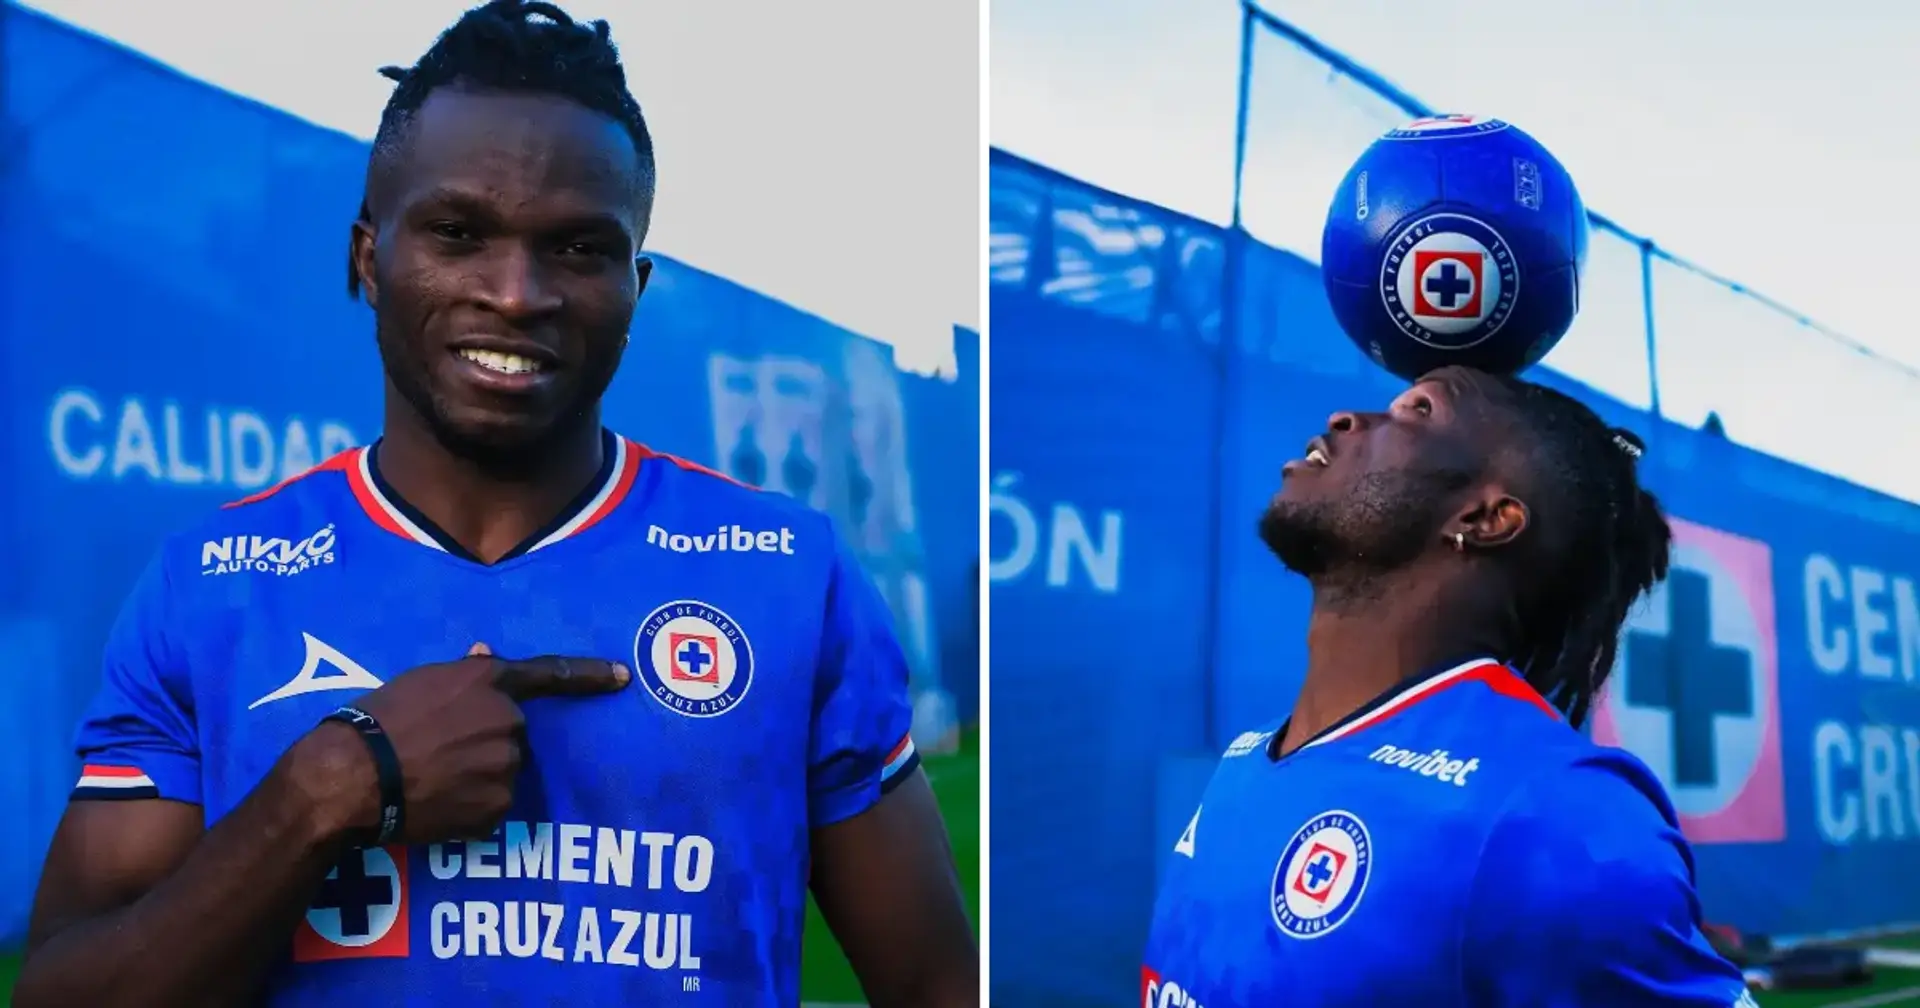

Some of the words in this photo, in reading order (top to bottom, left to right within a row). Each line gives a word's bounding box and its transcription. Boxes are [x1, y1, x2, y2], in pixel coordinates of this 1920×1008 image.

[646, 523, 796, 556] novibet
[646, 612, 671, 637] CLUB
[676, 606, 691, 617] DE
[655, 686, 694, 712] CRUZ
[700, 692, 736, 713] AZUL
[1368, 743, 1480, 788] novibet
[428, 820, 715, 893] CEMENTO
[430, 900, 565, 962] CRUZ
[572, 906, 701, 971] AZUL
[682, 976, 701, 992] MR
